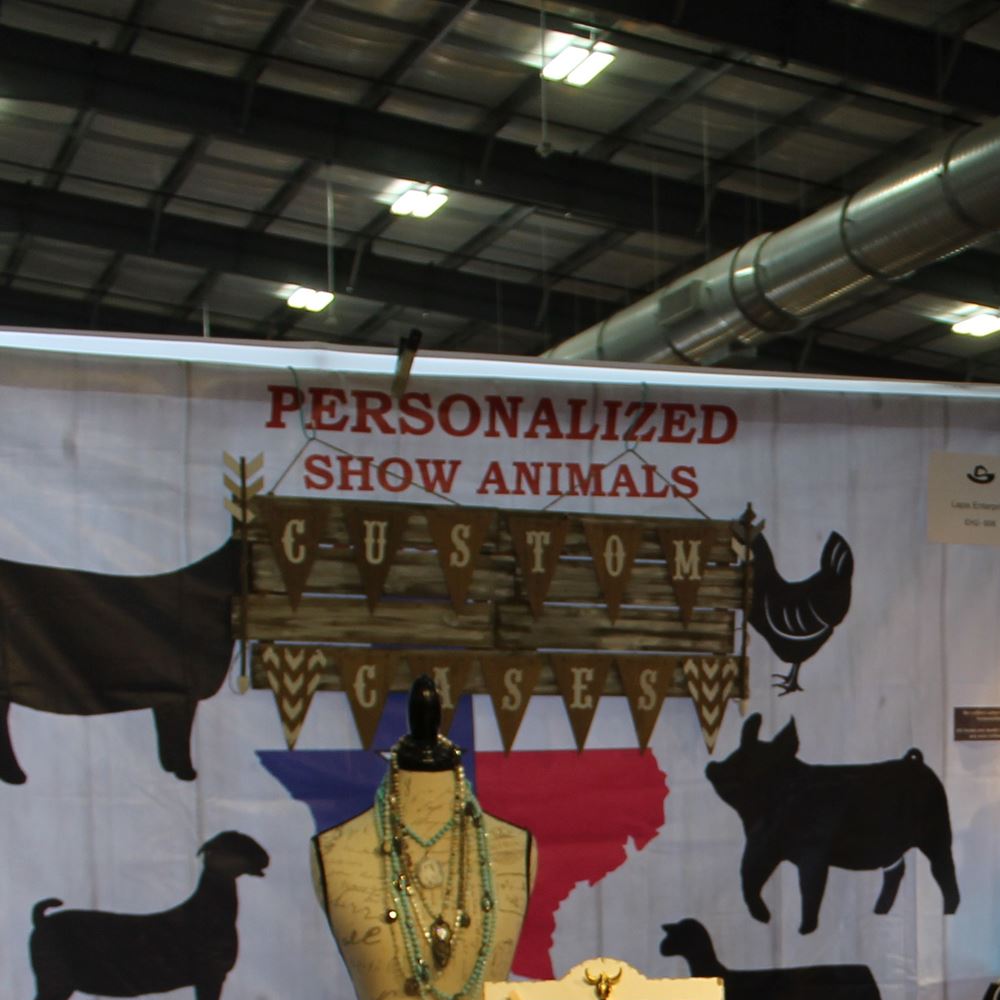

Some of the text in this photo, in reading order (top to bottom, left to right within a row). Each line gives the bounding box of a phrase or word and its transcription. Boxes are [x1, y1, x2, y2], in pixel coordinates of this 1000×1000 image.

[265, 385, 738, 445] PERSONALIZED
[304, 453, 699, 500] SHOW ANIMALS
[282, 518, 701, 581] CUSTOM
